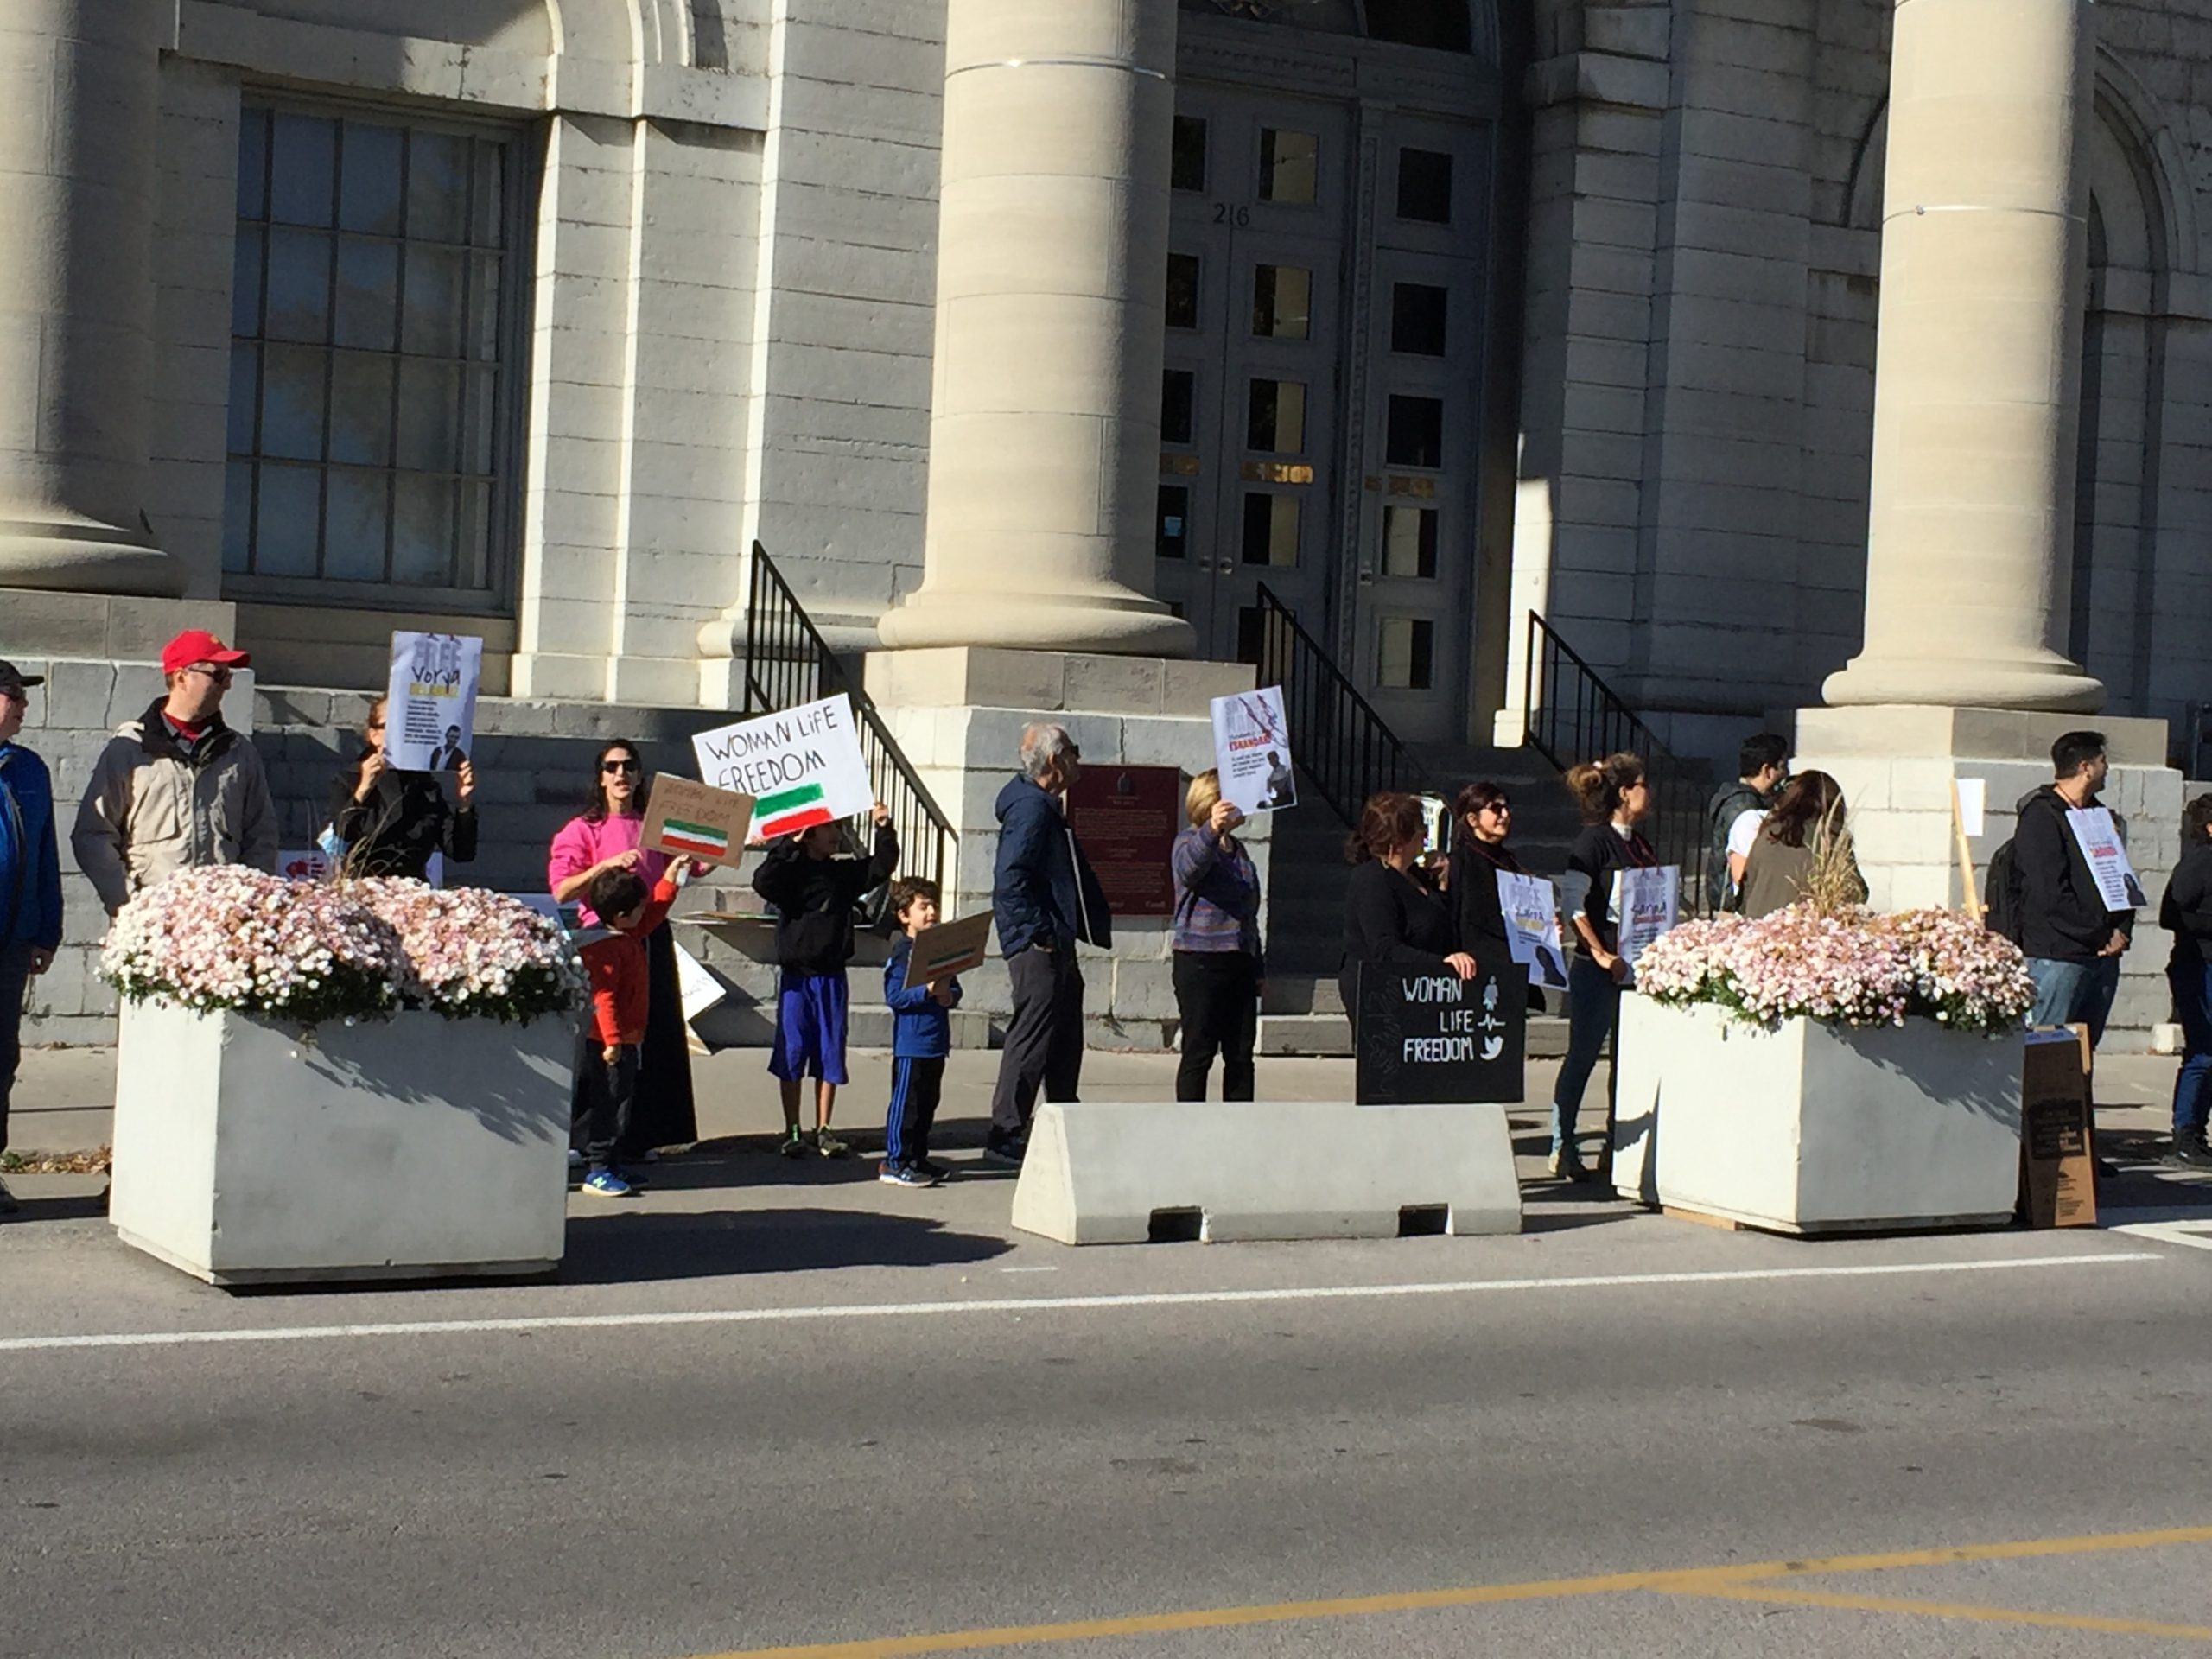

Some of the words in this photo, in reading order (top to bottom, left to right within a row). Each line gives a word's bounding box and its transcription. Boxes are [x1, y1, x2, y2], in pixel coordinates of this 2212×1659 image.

[1213, 203, 1249, 226] 216
[705, 721, 791, 760] WOMAN
[719, 750, 826, 794] FREEDOM
[1402, 976, 1462, 1002] WOMAN
[1440, 1009, 1474, 1032] LIFE
[1403, 1036, 1474, 1063] FREEDOM
